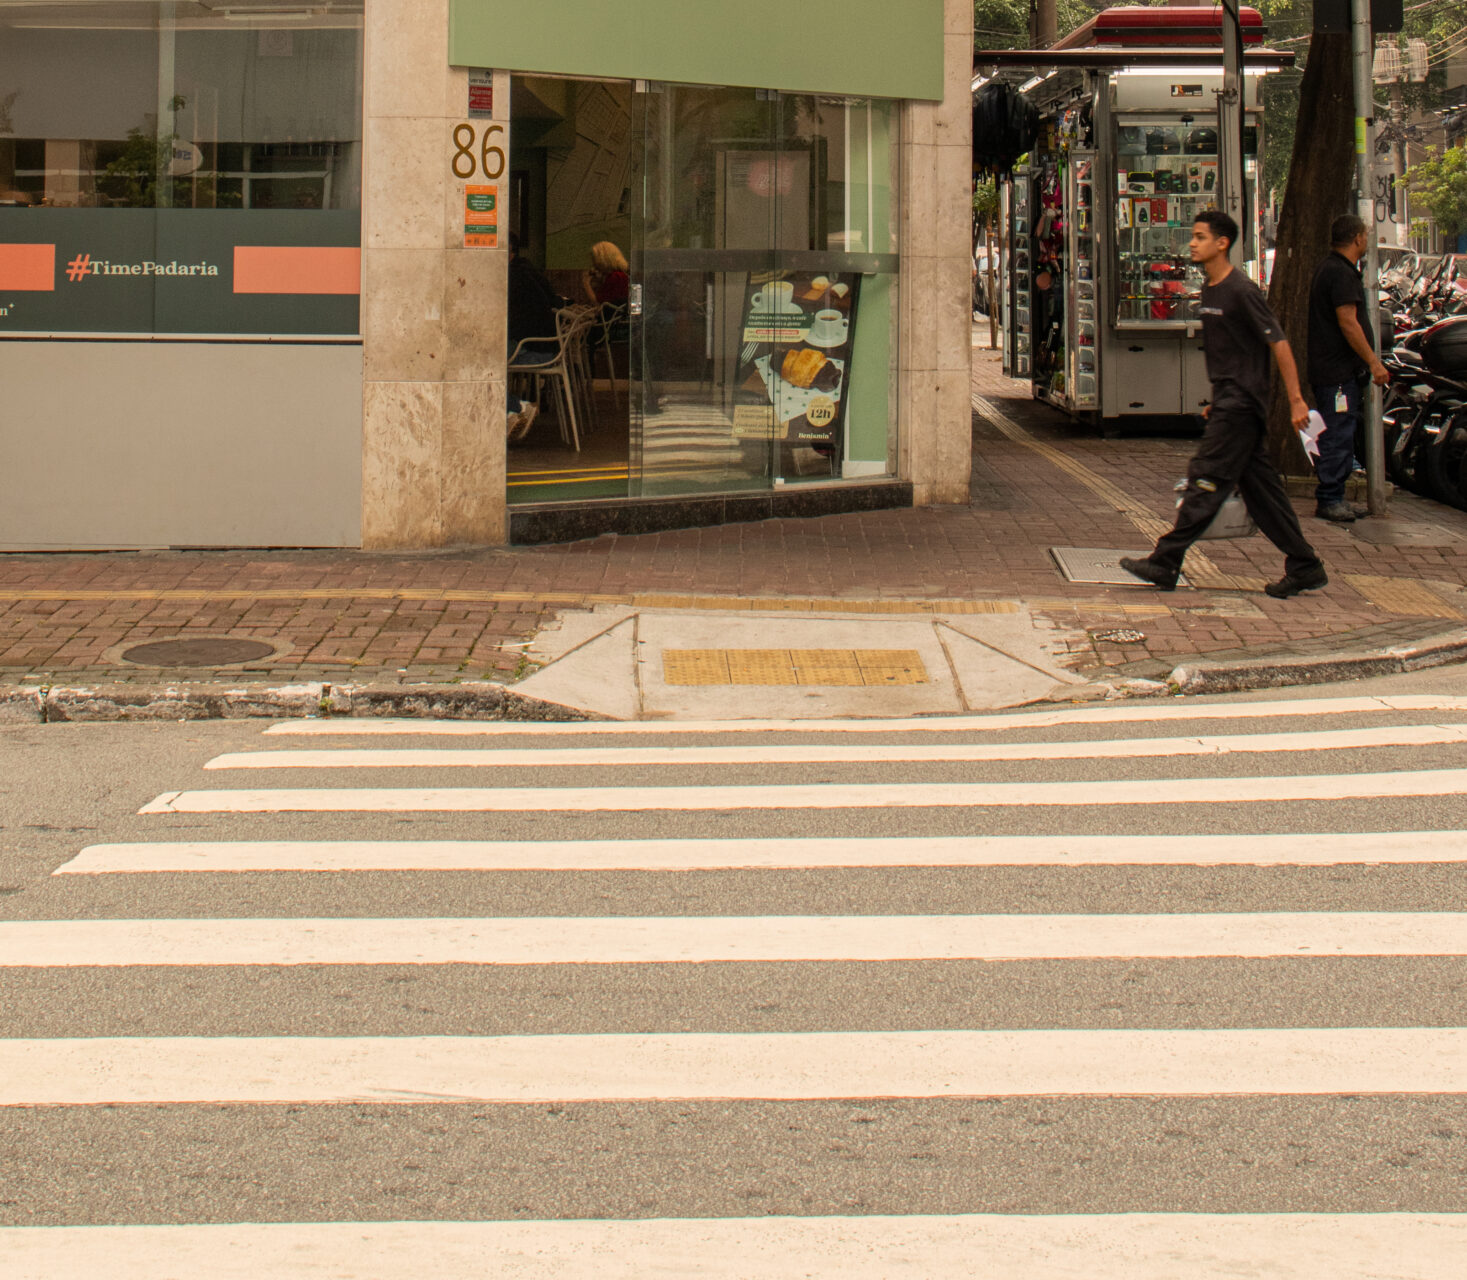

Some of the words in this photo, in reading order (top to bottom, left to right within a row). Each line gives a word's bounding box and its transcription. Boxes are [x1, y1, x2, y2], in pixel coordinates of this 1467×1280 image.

[452, 123, 505, 179] 86
[65, 253, 219, 282] #TimePadaria
[810, 408, 831, 418] 12h
